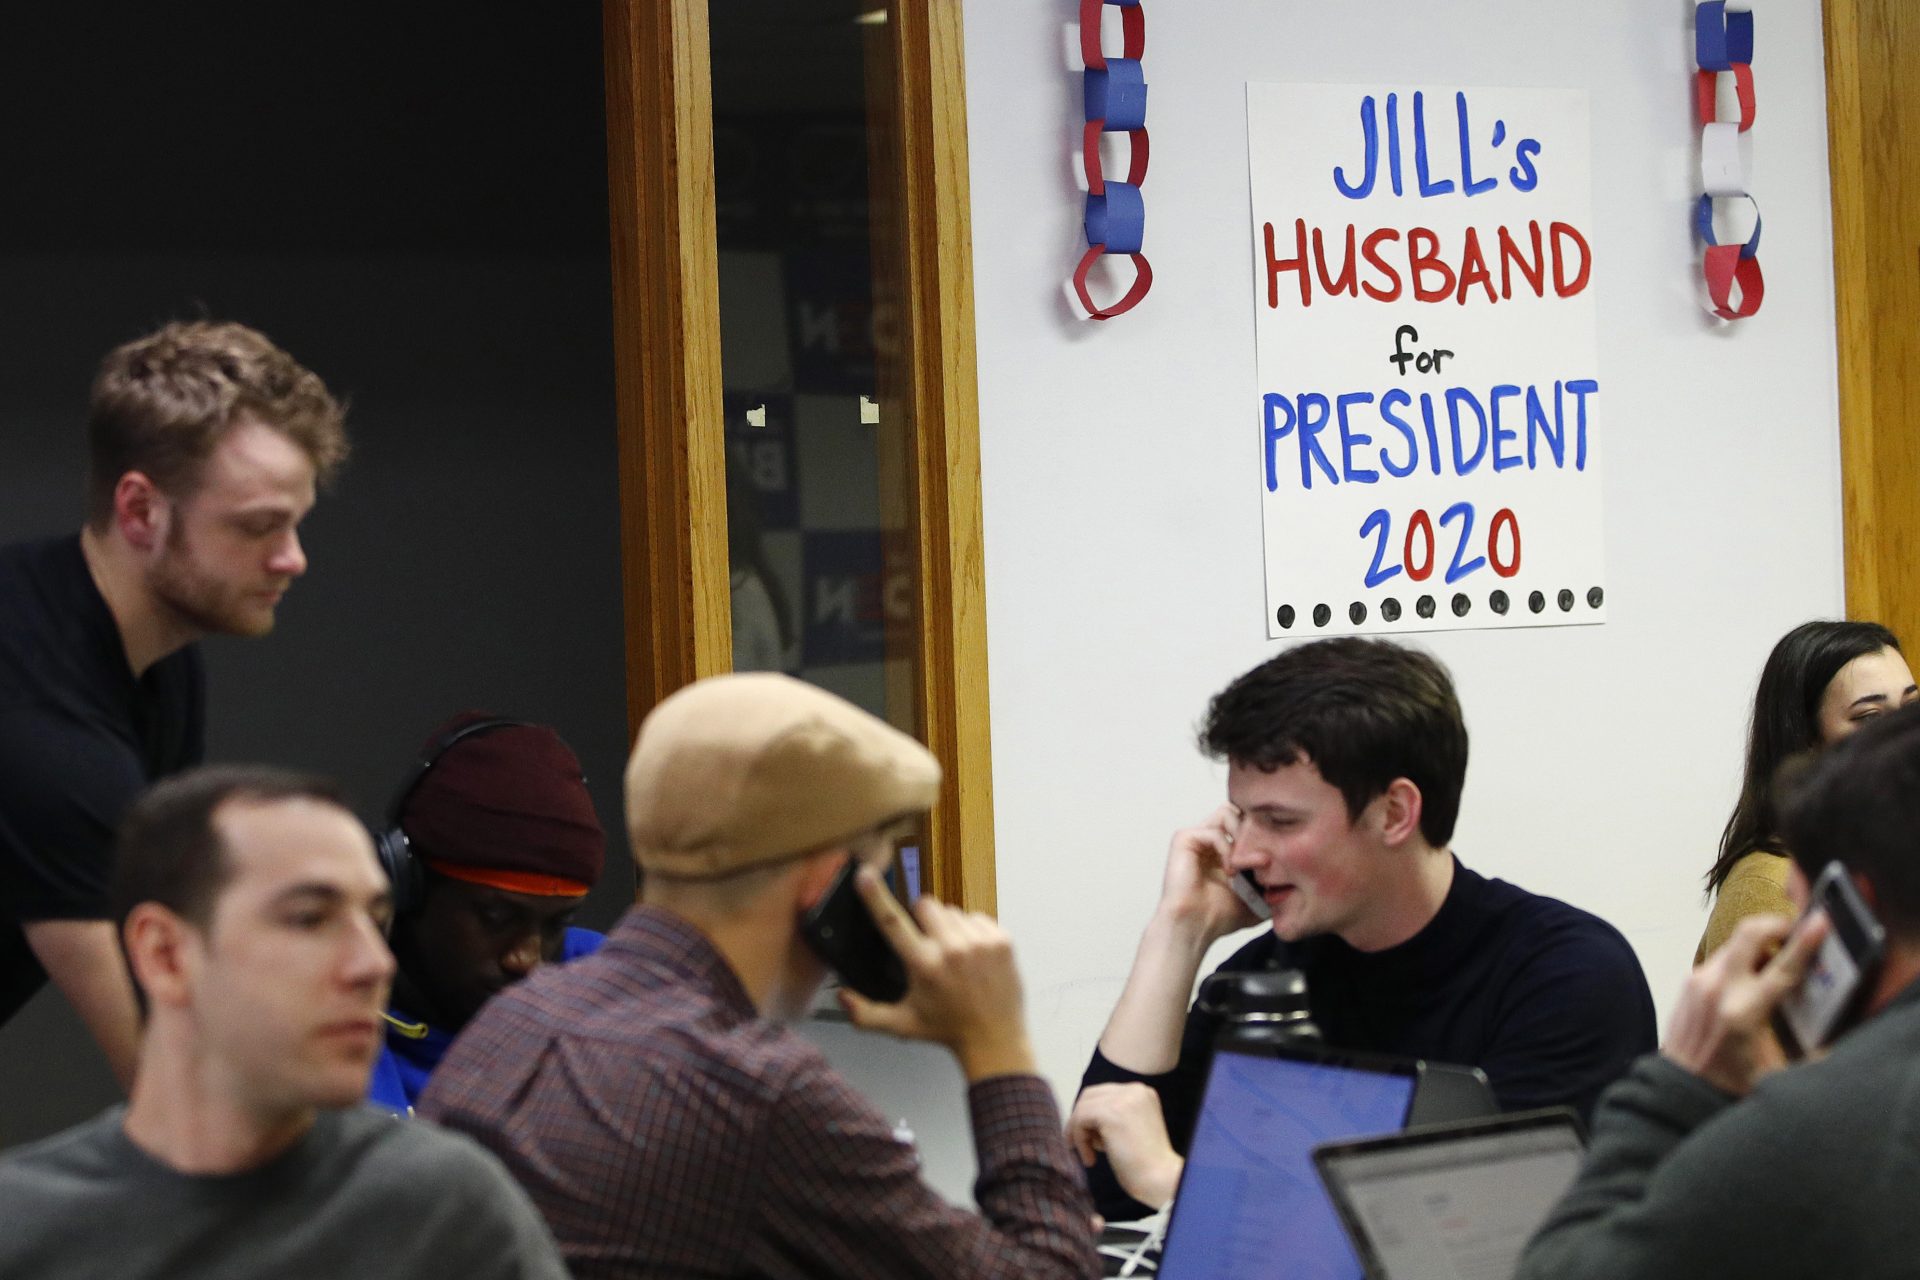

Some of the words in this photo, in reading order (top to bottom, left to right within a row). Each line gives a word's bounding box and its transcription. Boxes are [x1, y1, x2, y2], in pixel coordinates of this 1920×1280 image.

[1333, 90, 1541, 200] JILL's
[1263, 218, 1592, 309] HUSBAND
[1389, 324, 1455, 376] for
[1262, 379, 1599, 492] PRESIDENT
[1359, 501, 1521, 589] 2020
